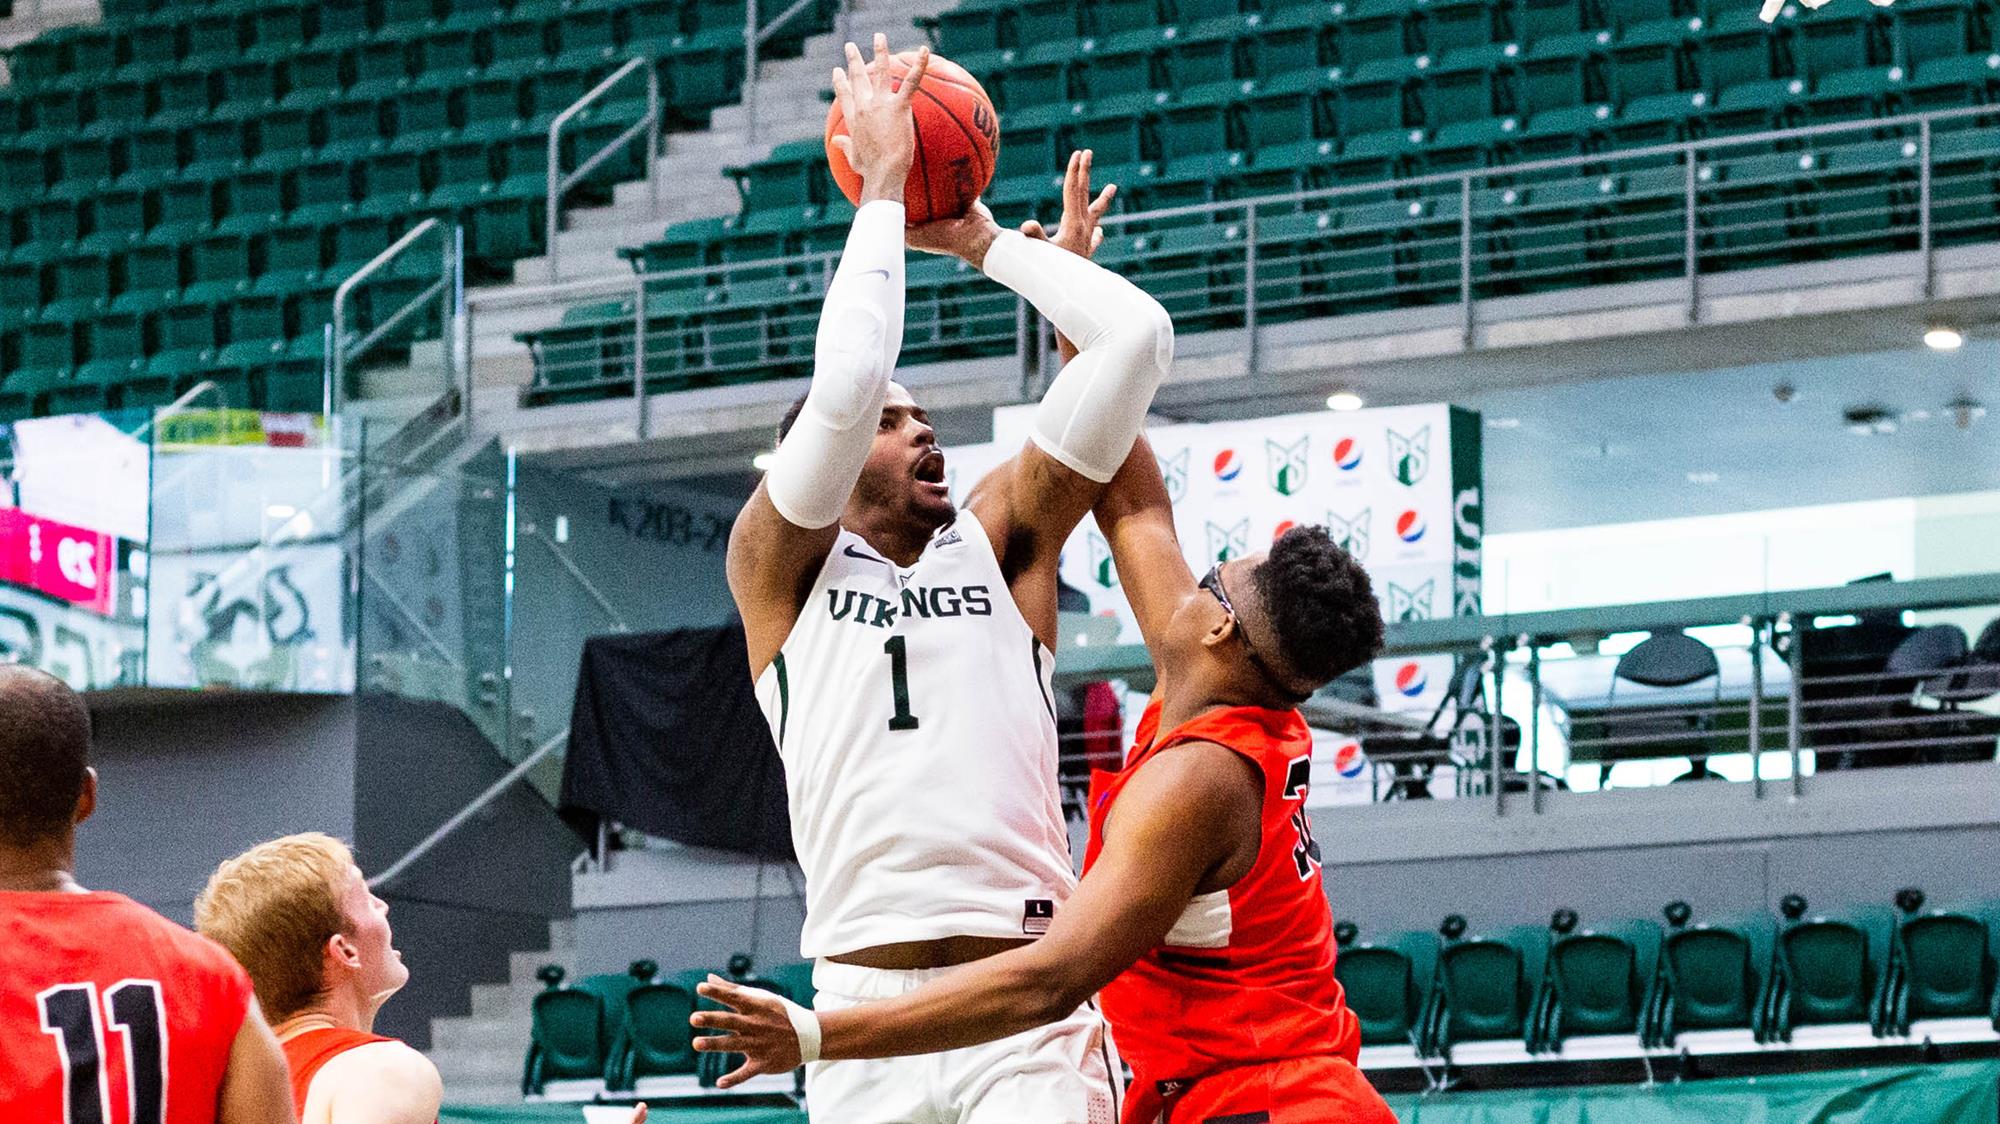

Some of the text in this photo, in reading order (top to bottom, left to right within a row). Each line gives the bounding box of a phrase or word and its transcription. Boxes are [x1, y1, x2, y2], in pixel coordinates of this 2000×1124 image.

[827, 585, 992, 628] VIKNGS
[884, 635, 919, 731] 1
[1036, 903, 1045, 914] L
[37, 979, 170, 1124] 11
